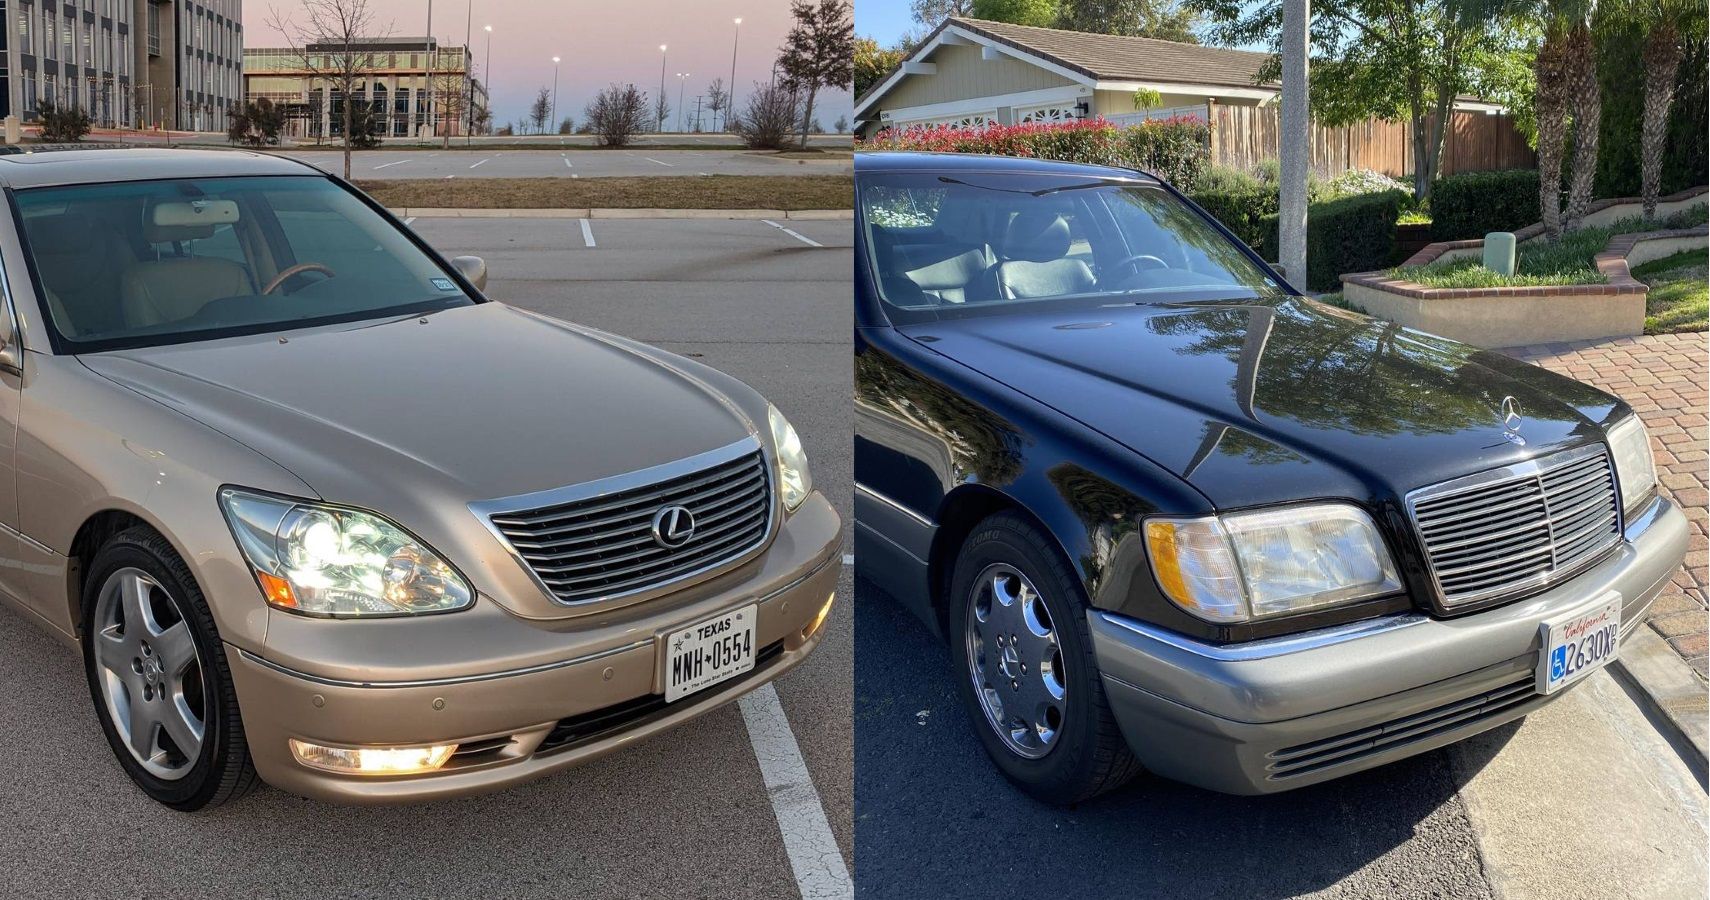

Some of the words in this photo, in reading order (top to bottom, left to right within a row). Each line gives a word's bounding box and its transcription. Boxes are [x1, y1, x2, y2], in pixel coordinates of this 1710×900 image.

[697, 618, 731, 640] TEXAS
[1565, 613, 1609, 639] California
[673, 647, 703, 687] MNH
[713, 629, 750, 669] 0554
